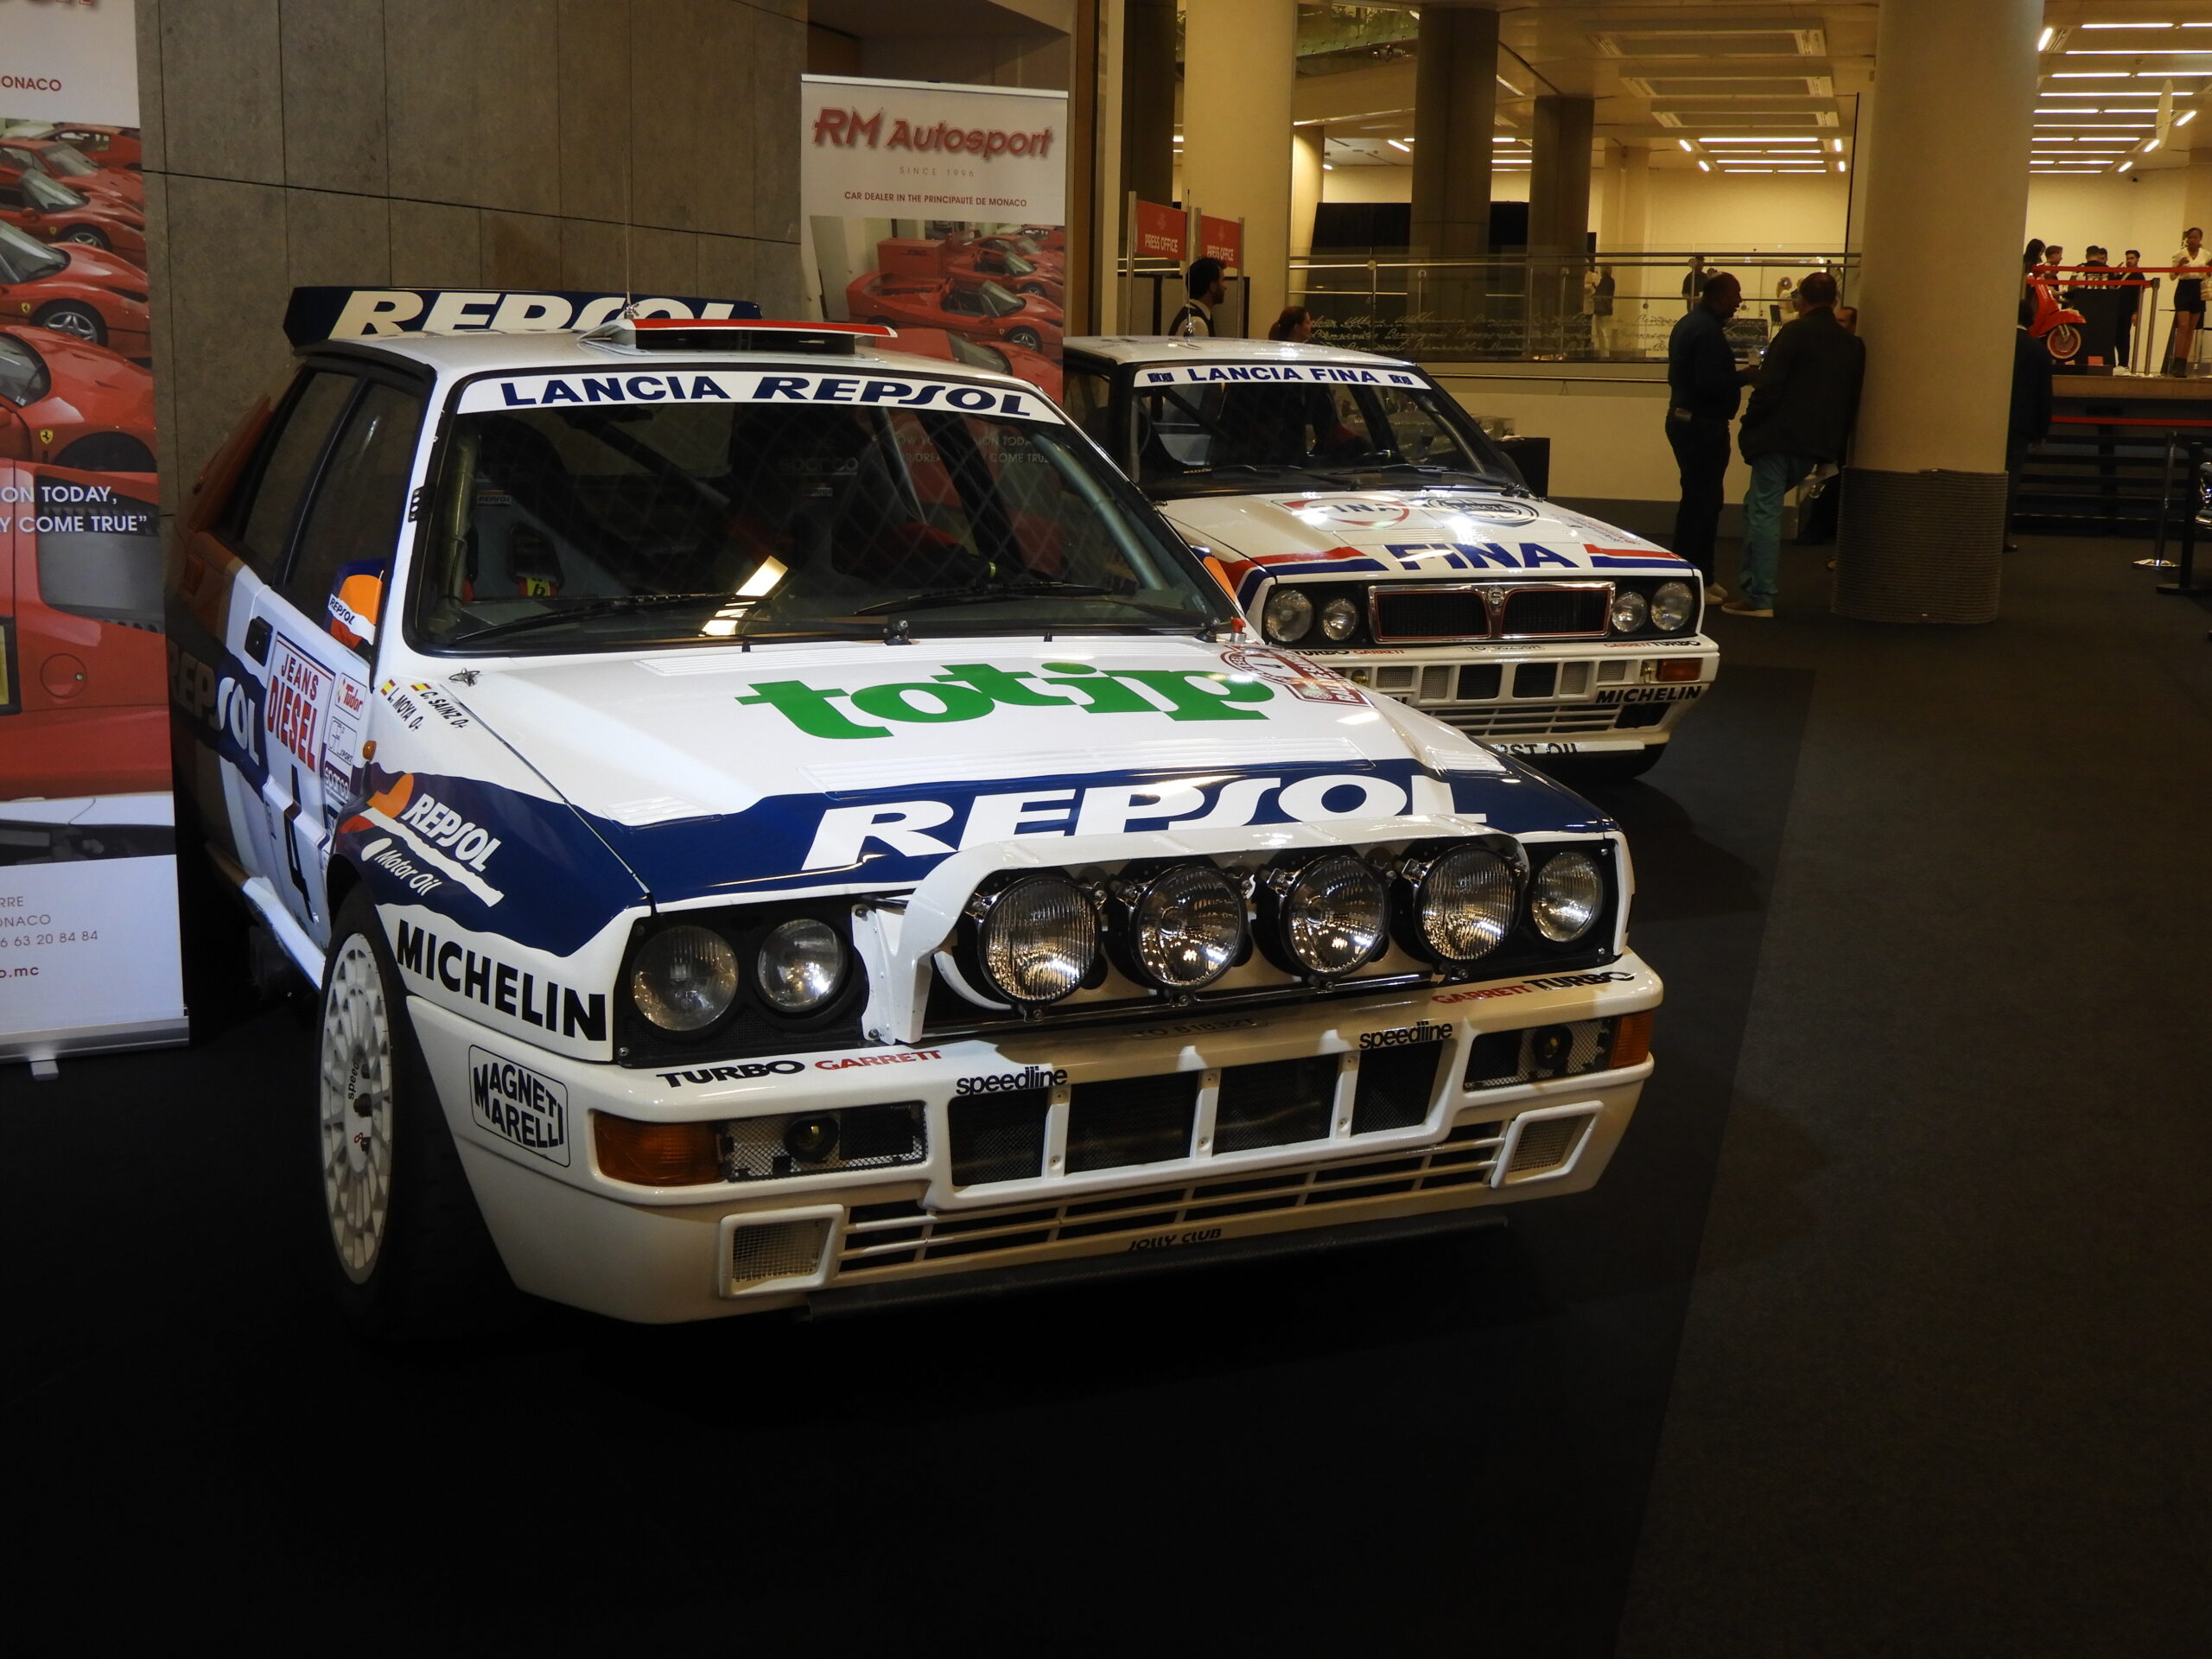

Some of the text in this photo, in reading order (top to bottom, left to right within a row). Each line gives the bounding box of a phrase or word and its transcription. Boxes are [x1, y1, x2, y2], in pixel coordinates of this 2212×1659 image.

[813, 106, 1052, 159] RM Autosport
[899, 167, 937, 175] SINCE
[865, 193, 894, 201] DEALER
[988, 199, 1027, 207] MONACO
[1145, 233, 1179, 253] PRESS OFFICE
[1206, 245, 1234, 262] PRESS OFFICE
[1186, 367, 1304, 381] LANCIA
[1309, 368, 1381, 383] FINA
[500, 376, 1031, 416] LANCIA REPSOL
[41, 486, 118, 505] TODAY,
[19, 516, 85, 533] COME
[1382, 543, 1580, 570] FINA
[329, 597, 356, 625] REPSOL
[281, 654, 319, 701] JEANS
[343, 683, 364, 712] Tudor
[392, 695, 417, 721] MOYA
[429, 699, 462, 720] SAINZ
[735, 662, 1272, 741] totip
[1595, 686, 1701, 704] MICHELIN
[268, 675, 317, 772] DIESEL
[401, 793, 502, 873] REPSOL
[801, 774, 1487, 873] REPSOL
[374, 849, 442, 897] Motor Oil
[0, 914, 51, 927] NACO
[0, 931, 98, 948] 6 63 20 84 84
[397, 919, 607, 1041] MICHELIN
[1431, 971, 1636, 1003] GARRETT TURBO
[1359, 1021, 1452, 1050] speedline
[657, 1050, 942, 1088] TURBO GARRETT
[957, 1066, 1068, 1096] speedline
[474, 1063, 563, 1119] MAGNETI
[474, 1096, 564, 1148] MARELLI
[1128, 1229, 1222, 1251] JOLLY CLUB
